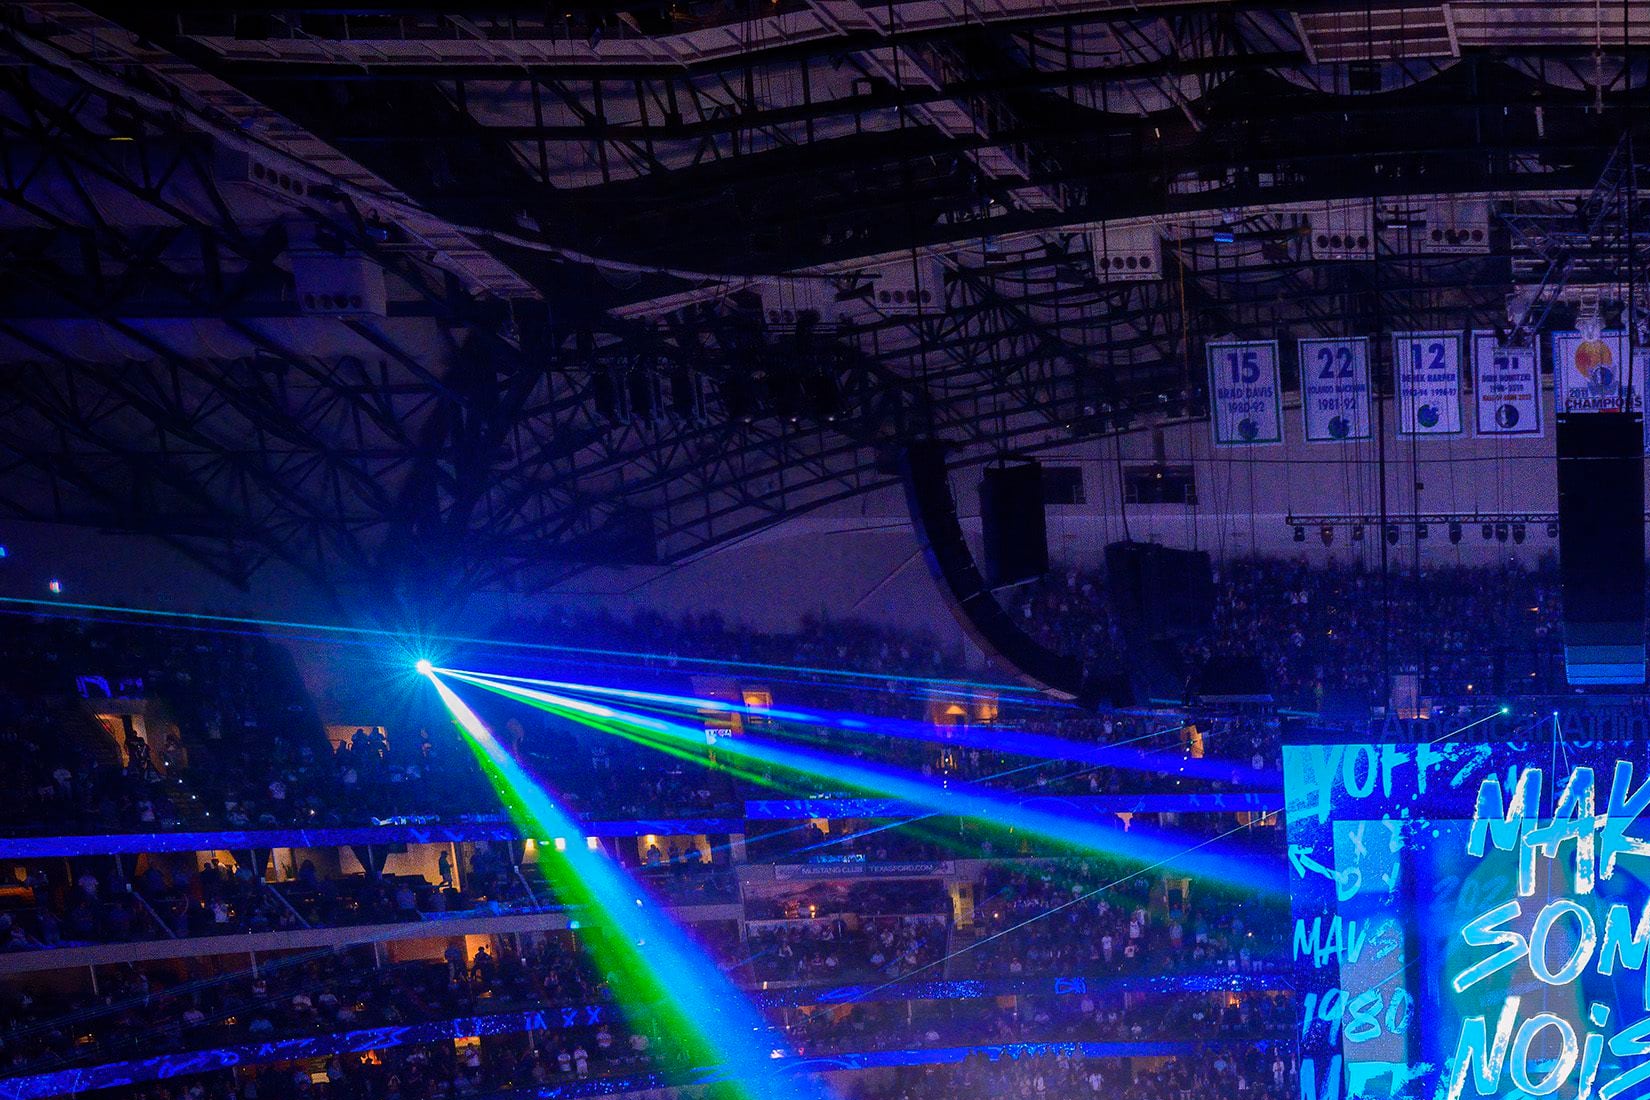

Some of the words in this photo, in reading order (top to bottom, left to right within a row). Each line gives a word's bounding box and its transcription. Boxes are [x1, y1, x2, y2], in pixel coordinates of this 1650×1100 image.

[1227, 352, 1261, 384] 15
[1318, 347, 1354, 379] 22
[1411, 343, 1446, 370] 12
[1218, 387, 1244, 400] BRAD
[1246, 386, 1274, 398] DAVIS
[1565, 397, 1643, 409] CHAMPIONS
[1300, 986, 1415, 1047] 1980
